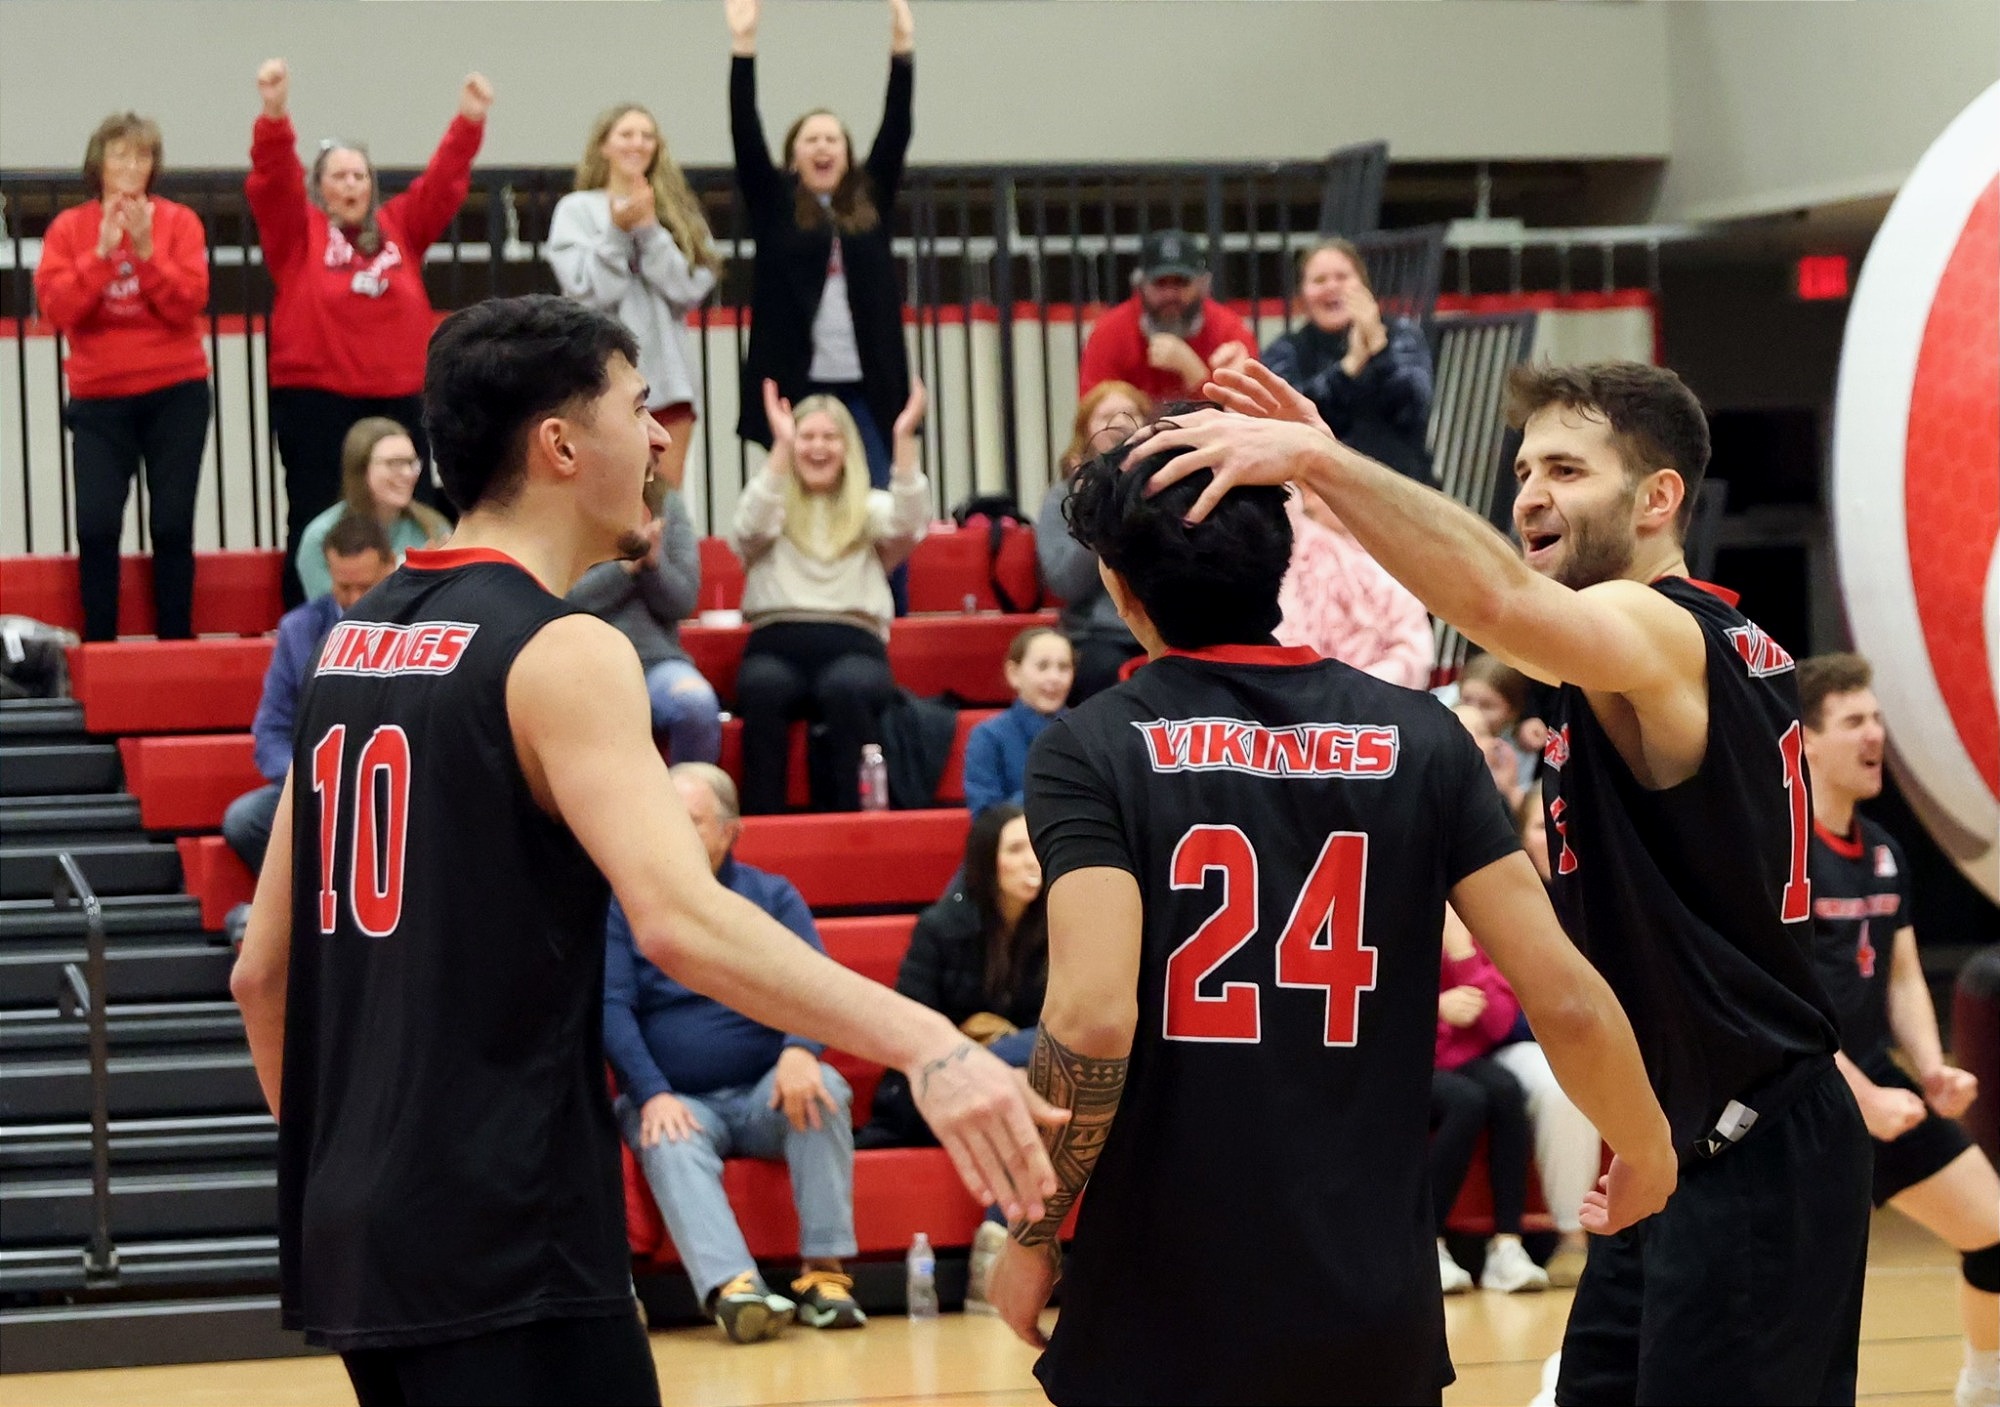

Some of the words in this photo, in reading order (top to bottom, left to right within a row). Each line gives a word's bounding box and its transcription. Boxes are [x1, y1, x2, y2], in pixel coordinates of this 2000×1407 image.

[315, 621, 479, 677] VIKINGS
[1131, 717, 1399, 779] VIKINGS
[313, 724, 411, 937] 10
[1162, 824, 1377, 1047] 24
